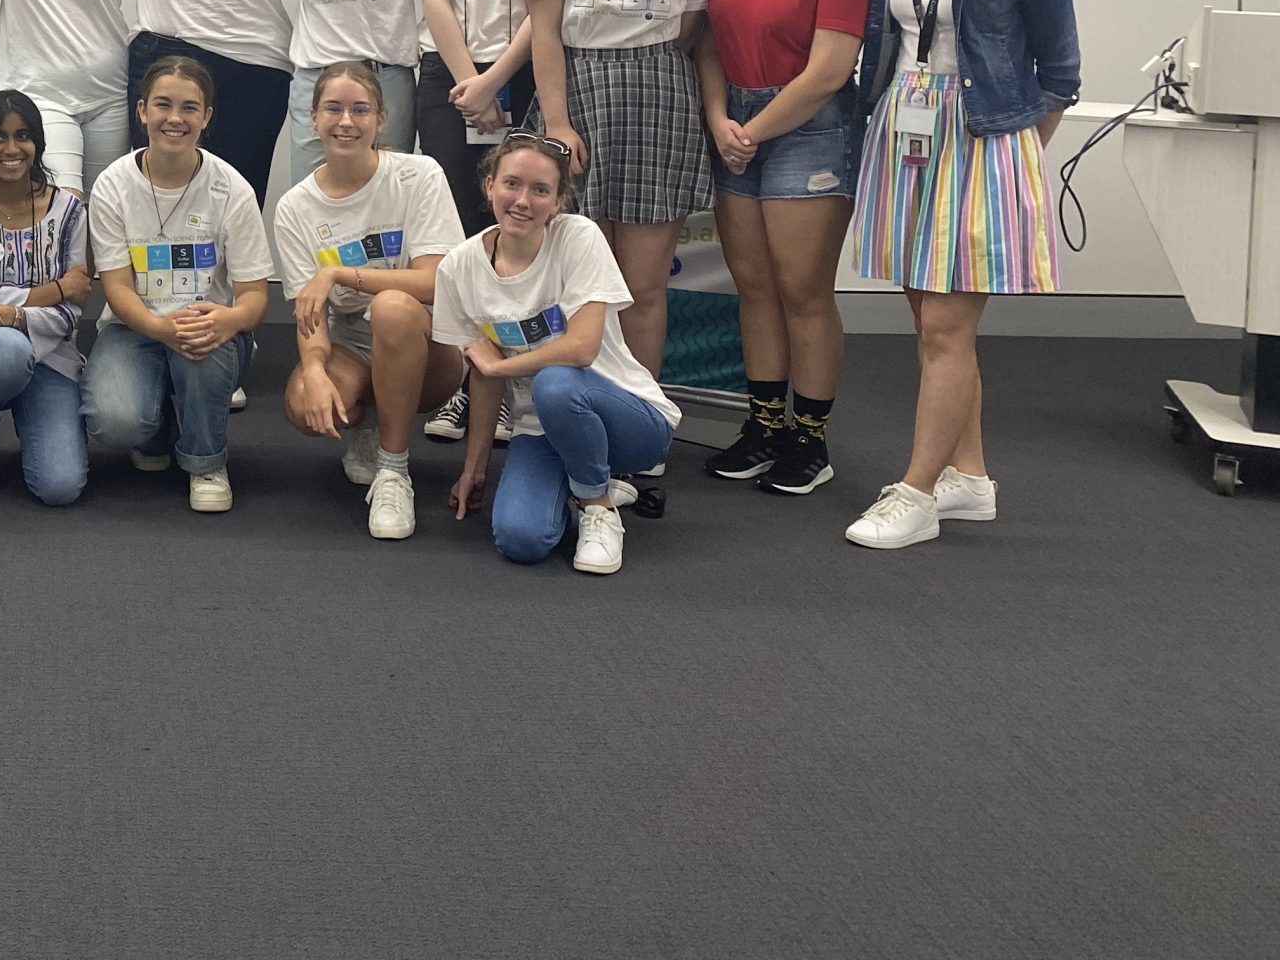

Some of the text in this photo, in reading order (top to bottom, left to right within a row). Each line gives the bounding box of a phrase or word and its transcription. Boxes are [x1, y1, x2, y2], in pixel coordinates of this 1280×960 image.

[181, 248, 187, 256] S
[204, 248, 209, 256] F
[346, 247, 353, 255] Y
[182, 277, 187, 285] 2
[531, 322, 538, 330] S
